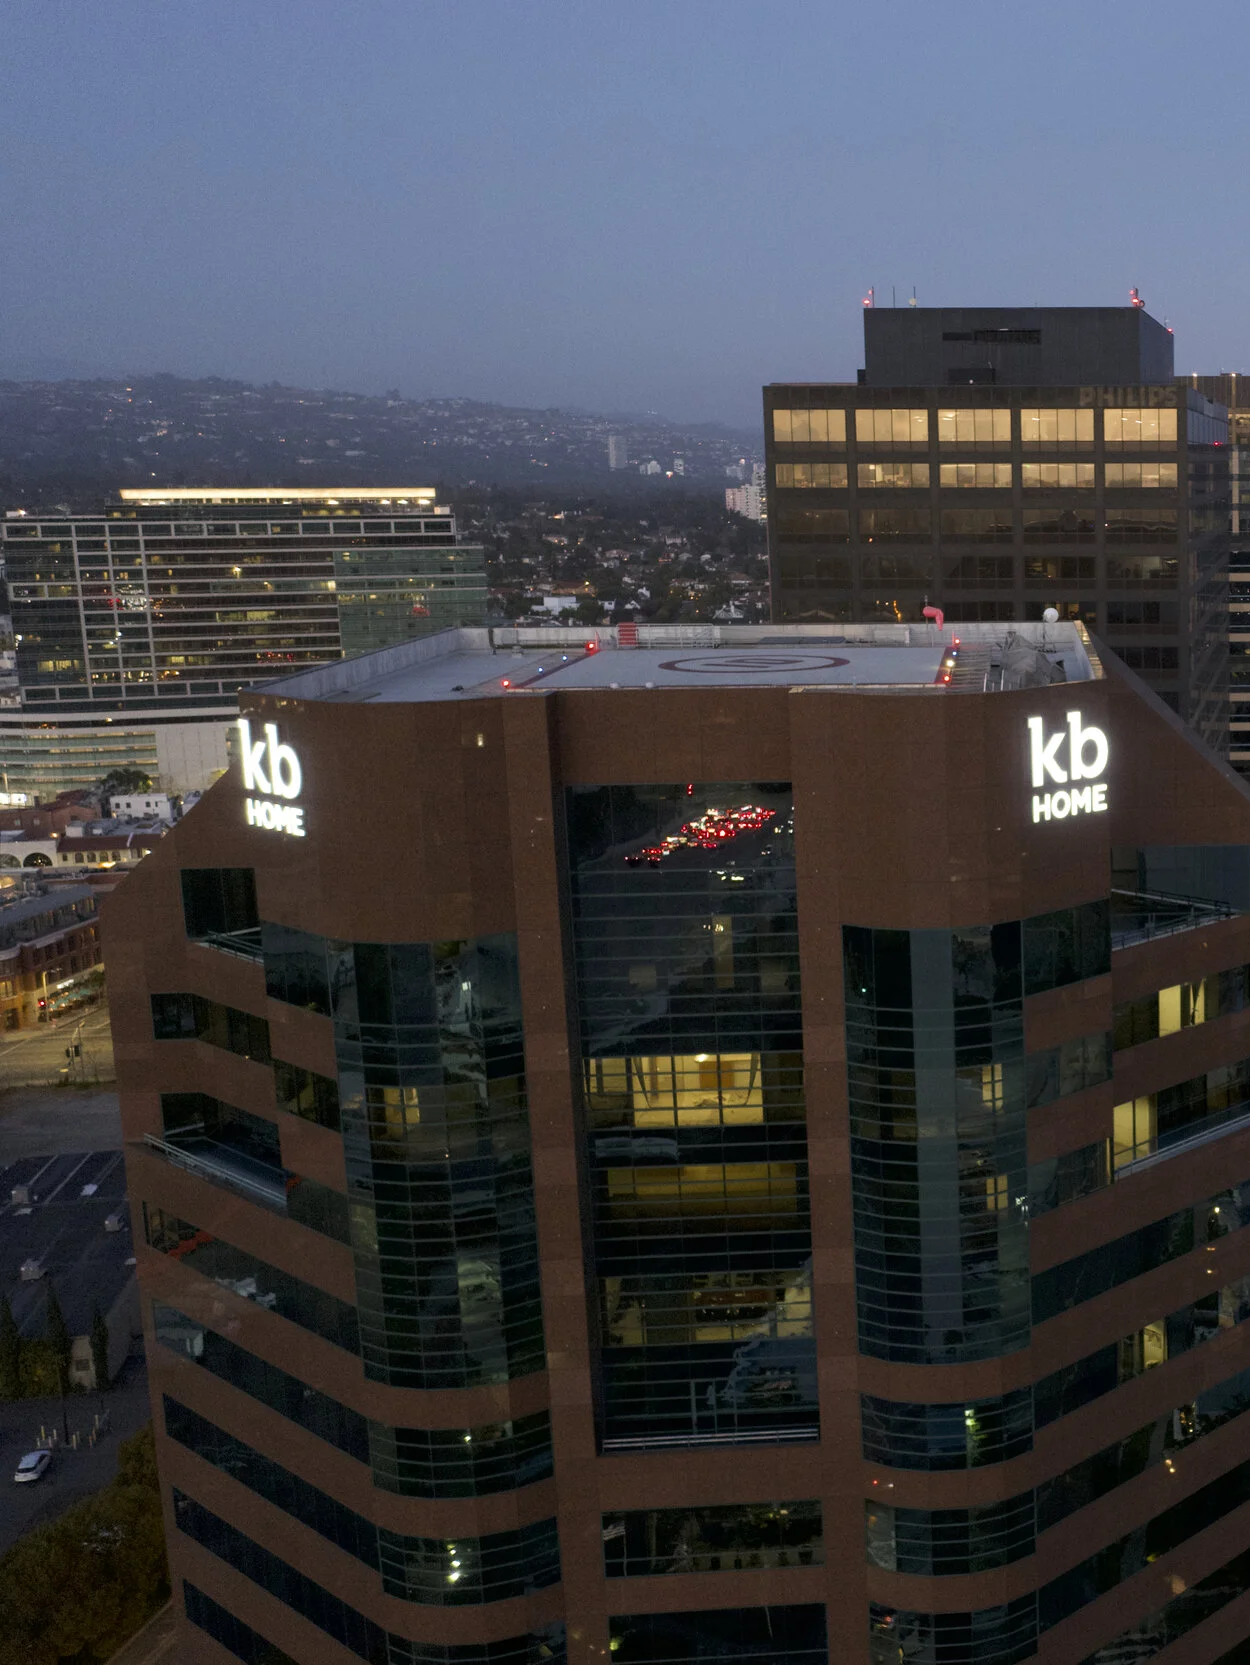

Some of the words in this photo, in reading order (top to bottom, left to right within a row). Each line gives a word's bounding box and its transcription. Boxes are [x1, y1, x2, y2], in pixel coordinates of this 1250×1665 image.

[1080, 387, 1177, 407] PHILIPS
[238, 718, 302, 799] kb
[1028, 711, 1109, 788] kb
[246, 798, 306, 837] HOME
[1033, 784, 1108, 823] HOME
